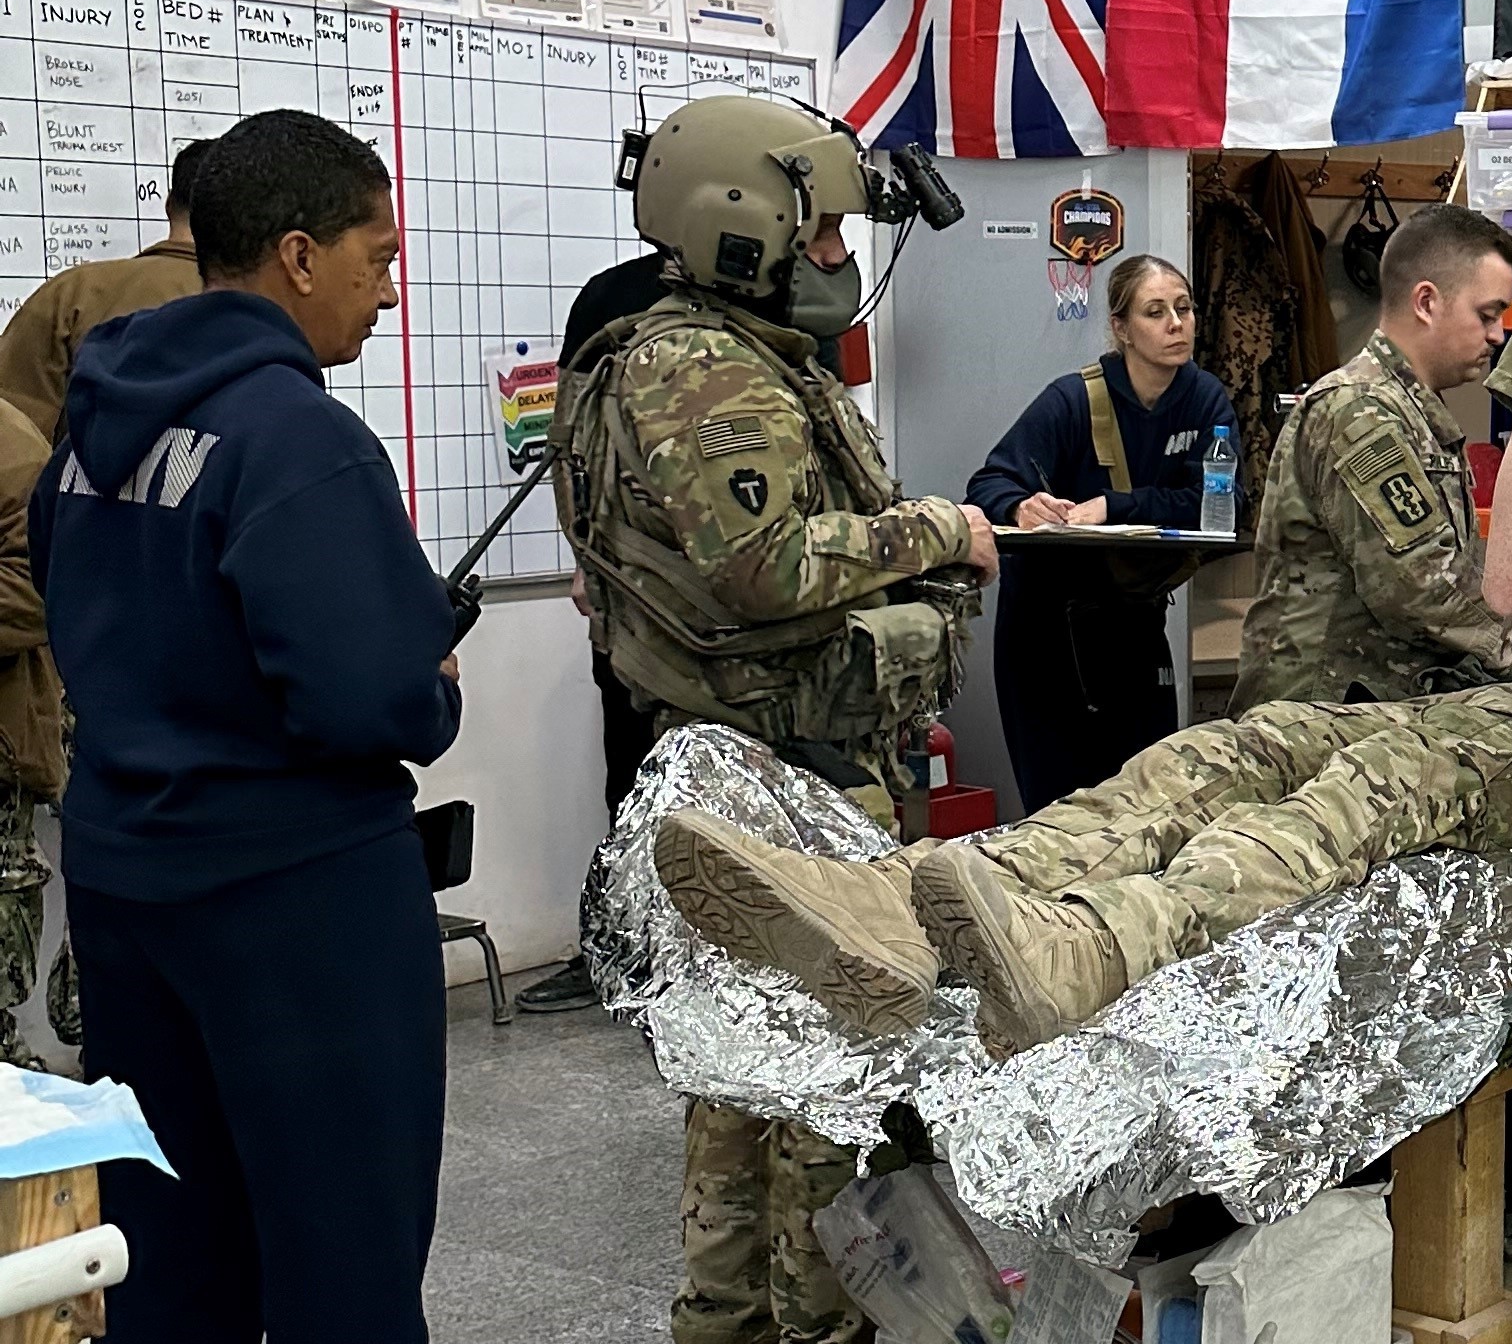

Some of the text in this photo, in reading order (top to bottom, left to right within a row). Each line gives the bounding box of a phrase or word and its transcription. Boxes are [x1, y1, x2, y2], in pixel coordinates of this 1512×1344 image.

[41, 2, 111, 26] INJURY
[208, 7, 223, 23] #
[237, 5, 274, 23] PLAN
[316, 13, 334, 28] PRI
[350, 18, 383, 33] DISPO
[399, 22, 413, 32] PT
[424, 25, 449, 36] TIME
[165, 32, 210, 49] TIME
[238, 29, 313, 51] TREATMENT
[401, 37, 411, 48] #
[497, 38, 534, 59] MOI
[548, 44, 596, 68] INJURY
[637, 50, 657, 63] BED
[45, 55, 94, 72] BROKEN
[617, 47, 628, 80] LOC
[690, 57, 718, 71] PLAN
[638, 67, 667, 80] TIME
[50, 76, 83, 88] NOSE
[773, 75, 800, 89] DISPO
[46, 120, 96, 139] BLUNT
[90, 142, 124, 153] CHEST
[46, 166, 82, 177] PELVIC
[50, 183, 86, 195] INJURY
[138, 180, 161, 201] OR
[50, 222, 88, 235] GLASS
[63, 239, 93, 250] HAND
[518, 392, 556, 406] DELAYE
